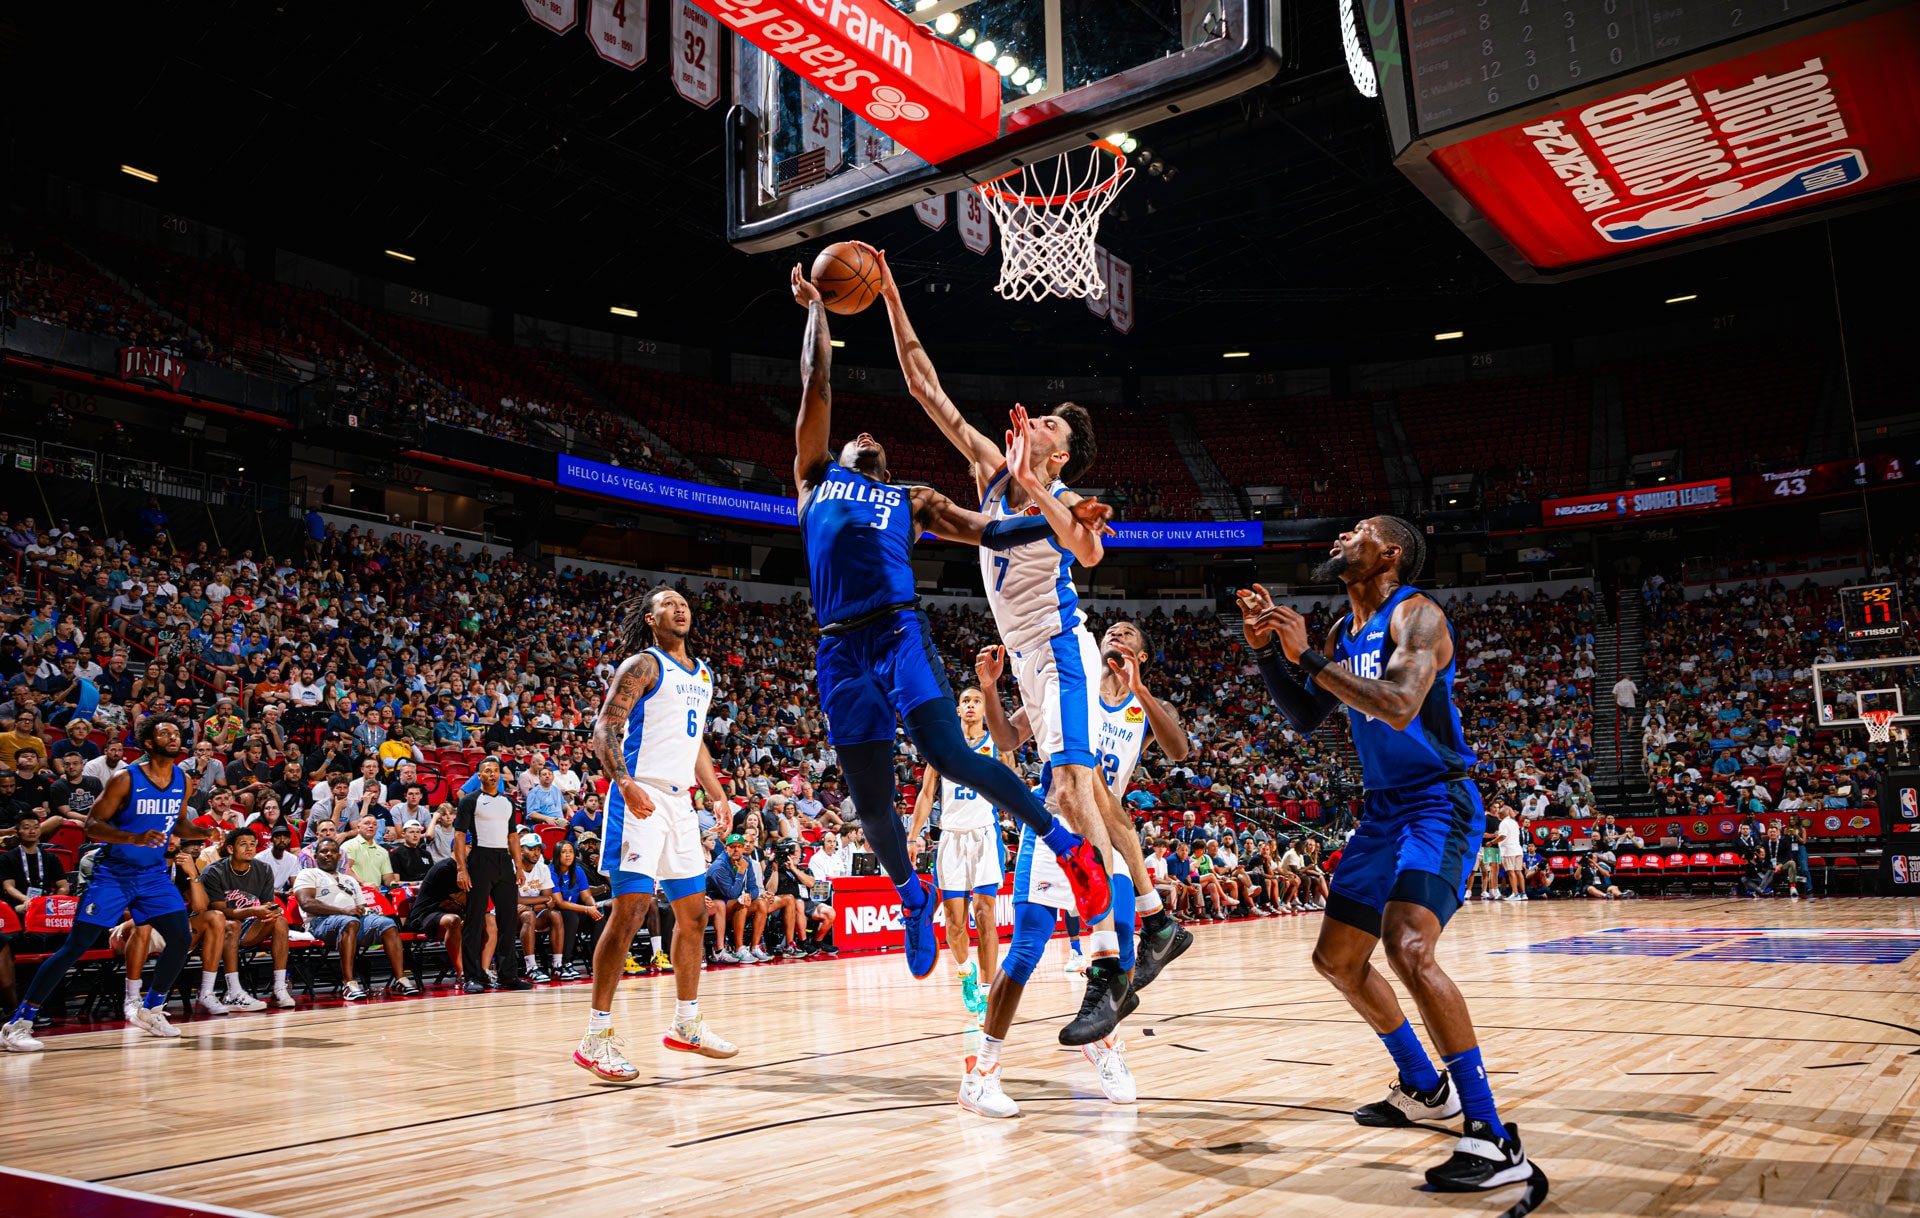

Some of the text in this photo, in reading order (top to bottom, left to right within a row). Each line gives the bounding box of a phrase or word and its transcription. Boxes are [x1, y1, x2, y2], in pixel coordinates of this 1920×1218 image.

[612, 0, 626, 28] 4
[683, 5, 708, 29] AUGMON
[1479, 13, 1491, 31] 8
[1519, 0, 1530, 16] 4
[1730, 8, 1743, 28] 2
[604, 32, 617, 44] 1989
[1482, 39, 1494, 56] 8
[1522, 25, 1534, 43] 2
[1563, 11, 1576, 29] 3
[1607, 22, 1619, 40] 0
[684, 30, 705, 72] 32
[1480, 61, 1501, 82] 12
[1525, 49, 1537, 67] 3
[1567, 35, 1577, 53] 1
[1610, 46, 1622, 64] 0
[1487, 87, 1499, 104] 6
[1528, 74, 1540, 91] 0
[1569, 60, 1581, 78] 5
[1703, 57, 1848, 168] LEAGUE
[1579, 78, 1732, 196] SUMMER
[1522, 120, 1620, 212] NBA2K24
[1801, 165, 1847, 191] NBA
[968, 193, 981, 224] 35
[162, 215, 187, 234] 210
[409, 291, 429, 307] 211
[1713, 314, 1735, 329] 217
[638, 340, 657, 355] 212
[1472, 352, 1493, 366] 216
[120, 346, 187, 392] UNLV
[848, 368, 866, 381] 213
[1255, 374, 1274, 386] 215
[1047, 378, 1065, 391] 214
[1762, 468, 1812, 481] Thunder
[1854, 462, 1866, 476] 1
[1889, 459, 1899, 470] 1
[567, 464, 599, 481] HELLO
[601, 472, 619, 486] LAS
[622, 477, 657, 494] VEGAS.
[691, 491, 771, 513] INTERMOUNTAIN
[816, 480, 901, 507] DALLAS
[1633, 484, 1718, 512] SUMMER LEAGUE
[1774, 478, 1807, 496] 43
[869, 503, 892, 530] 3
[1555, 502, 1609, 516] NBA2K24
[1151, 531, 1164, 539] OF
[1167, 530, 1193, 539] UNLV
[1195, 529, 1246, 539] ATHLETICS
[994, 556, 1009, 592] 7
[1864, 601, 1892, 624] 17
[676, 685, 709, 699] OKLAHOMA
[686, 696, 700, 707] CITY
[686, 709, 697, 737] 6
[136, 799, 182, 815] DALLAS
